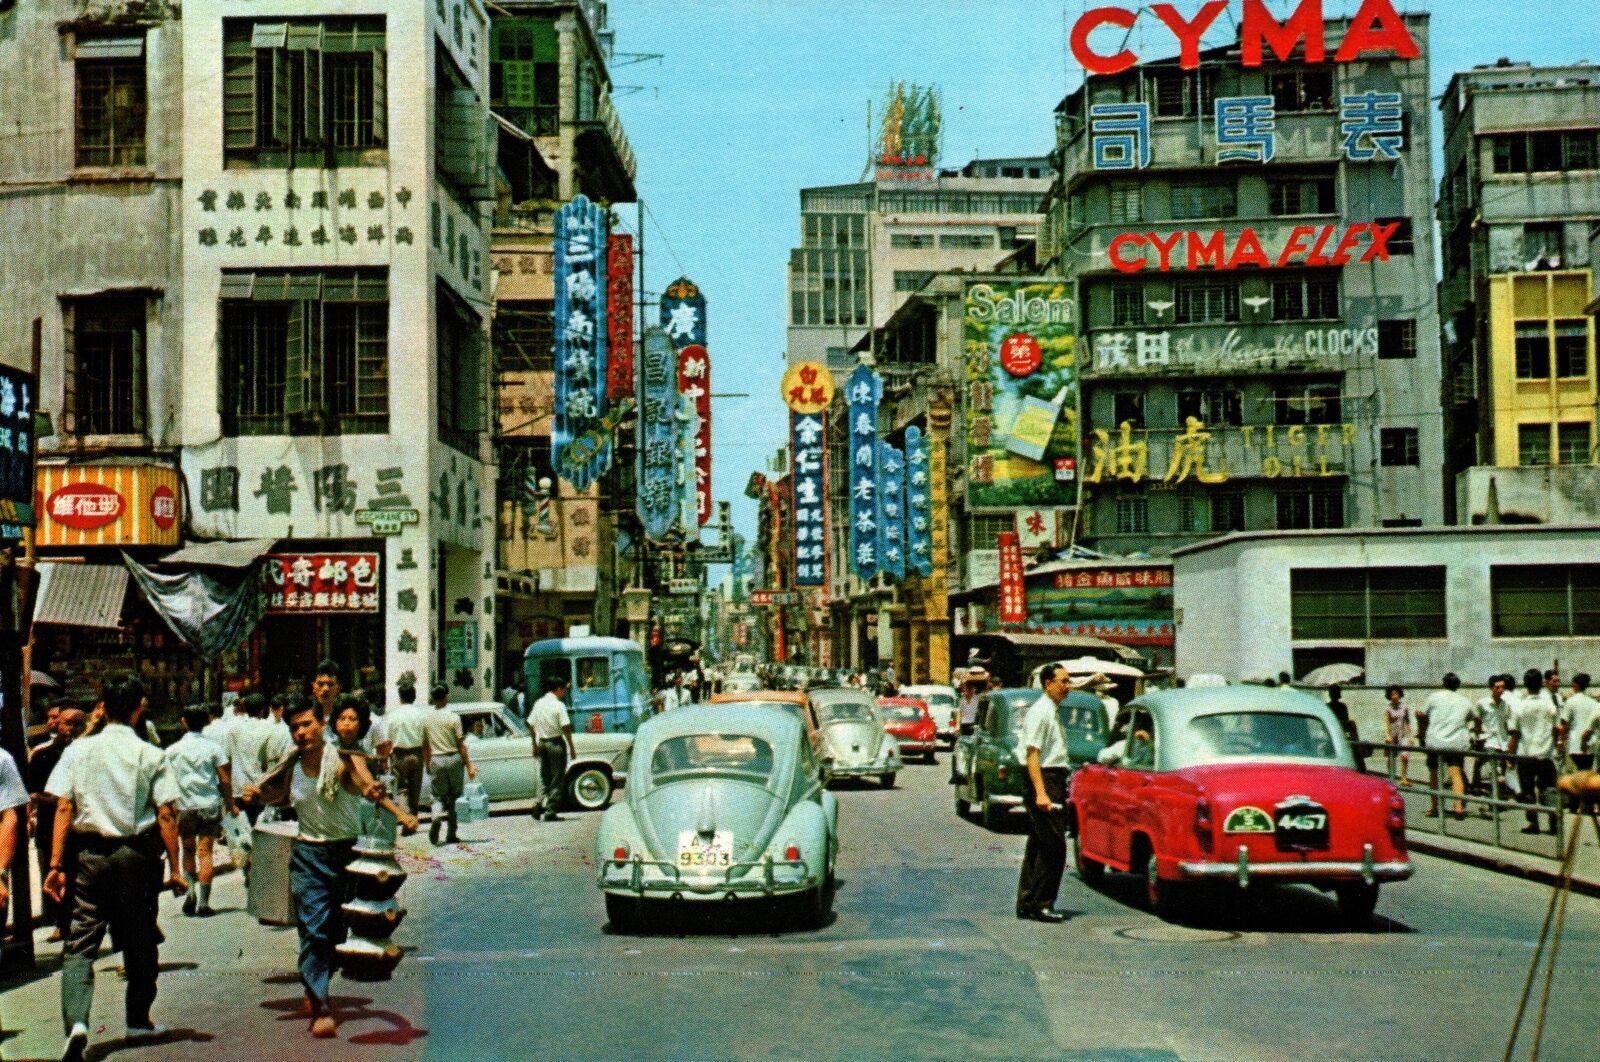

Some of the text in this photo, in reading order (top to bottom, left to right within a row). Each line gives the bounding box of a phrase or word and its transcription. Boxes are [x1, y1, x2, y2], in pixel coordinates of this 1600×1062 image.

[1070, 0, 1421, 75] CYMA
[1090, 92, 1403, 170] 司馬表
[1108, 222, 1402, 273] CYMA FLEX
[968, 283, 1075, 324] Salem
[1305, 329, 1378, 355] CLOCKS
[795, 416, 823, 504] 余仁生
[1264, 456, 1332, 478] OIL
